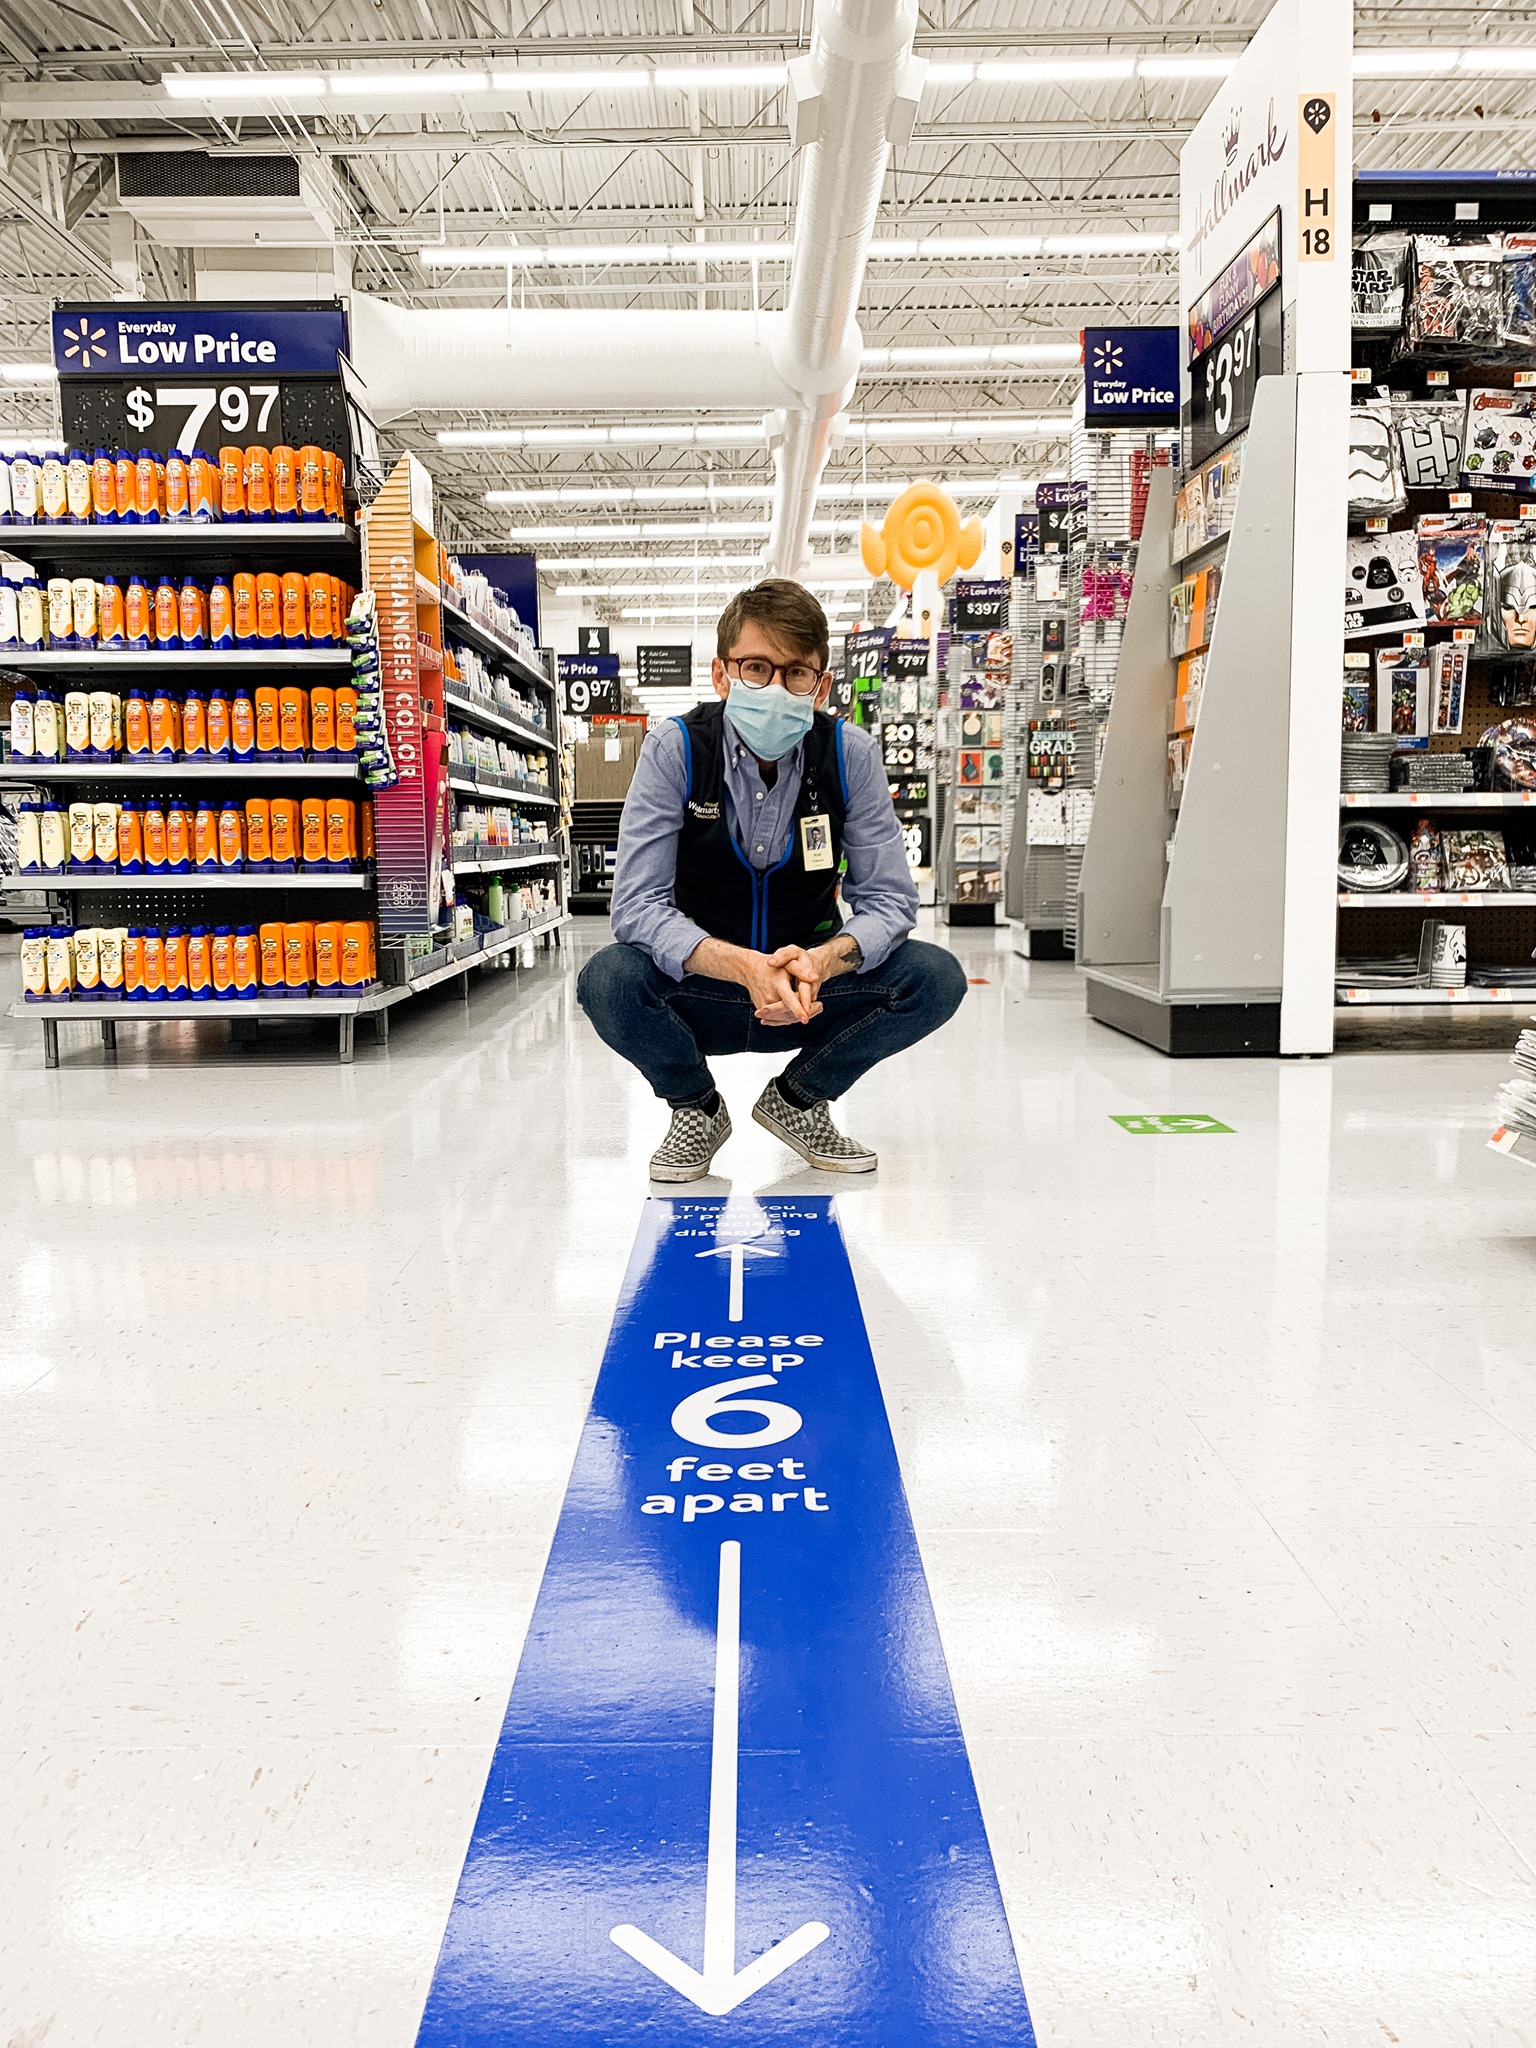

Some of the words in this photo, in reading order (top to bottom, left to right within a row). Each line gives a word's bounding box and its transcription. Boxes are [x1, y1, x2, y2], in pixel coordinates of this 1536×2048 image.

[1187, 97, 1288, 276] Hallmark
[1305, 188, 1328, 217] H
[1303, 229, 1329, 255] 18
[1220, 269, 1232, 293] FUN
[1352, 270, 1392, 282] STAR
[1220, 279, 1239, 310] FUNNY
[1352, 281, 1392, 294] WARS
[118, 321, 176, 336] Everyday
[118, 336, 188, 364] Low
[194, 332, 277, 363] Price
[1093, 389, 1129, 404] Low
[1132, 387, 1174, 403] Price
[390, 556, 412, 681] CHANGES
[571, 663, 598, 675] Price
[851, 650, 879, 678] $12
[395, 692, 416, 778] COLOR
[885, 724, 915, 741] 20
[885, 748, 915, 764] 20
[1030, 740, 1076, 755] GRAD
[688, 801, 719, 814] Walmart
[700, 1212, 818, 1221] practicing
[674, 1229, 801, 1237] distancing
[653, 1332, 824, 1350] Please
[671, 1351, 804, 1373] keep
[670, 1373, 803, 1449] 6
[665, 1456, 807, 1482] feet
[640, 1487, 830, 1523] apart
